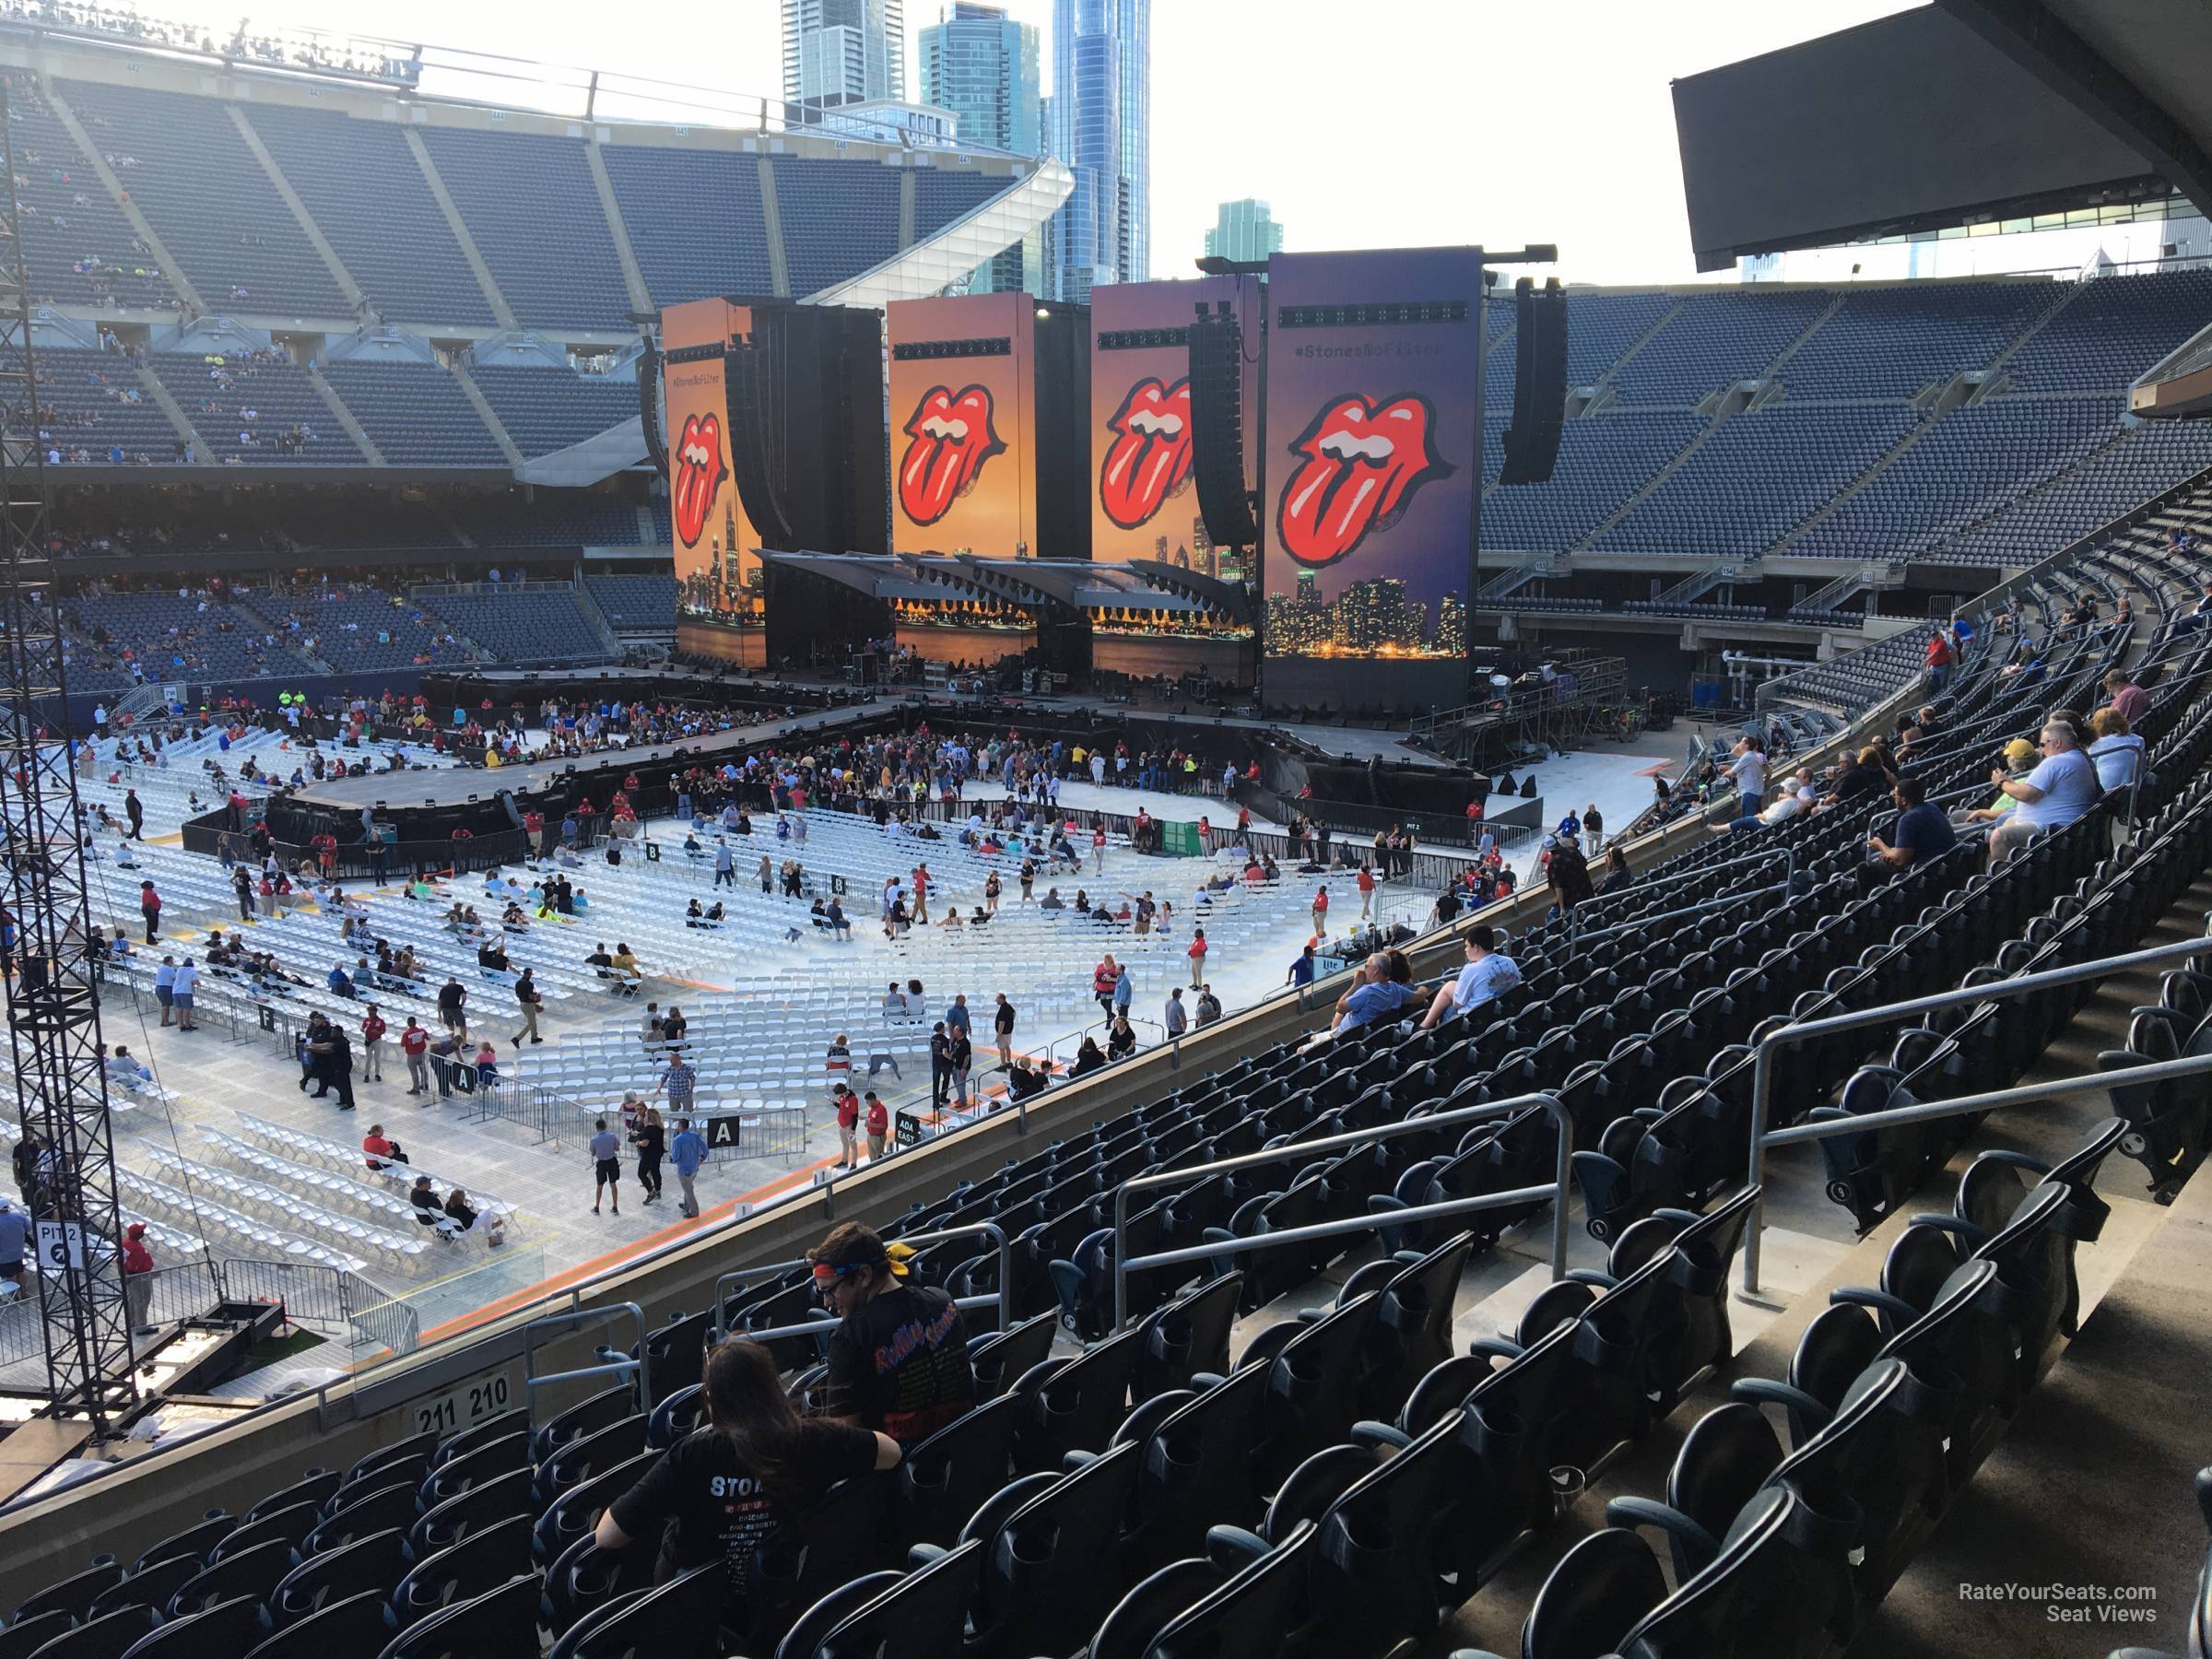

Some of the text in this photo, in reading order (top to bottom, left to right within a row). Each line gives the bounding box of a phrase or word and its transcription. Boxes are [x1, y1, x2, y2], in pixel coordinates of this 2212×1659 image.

[649, 846, 656, 858] B
[1323, 959, 1338, 971] Lite
[263, 1009, 270, 1026] F
[459, 1068, 468, 1088] A
[715, 1122, 732, 1143] A
[900, 1119, 914, 1133] ADA
[897, 1130, 915, 1144] EAST
[68, 1228, 76, 1241] 2
[419, 1377, 508, 1433] 211 210
